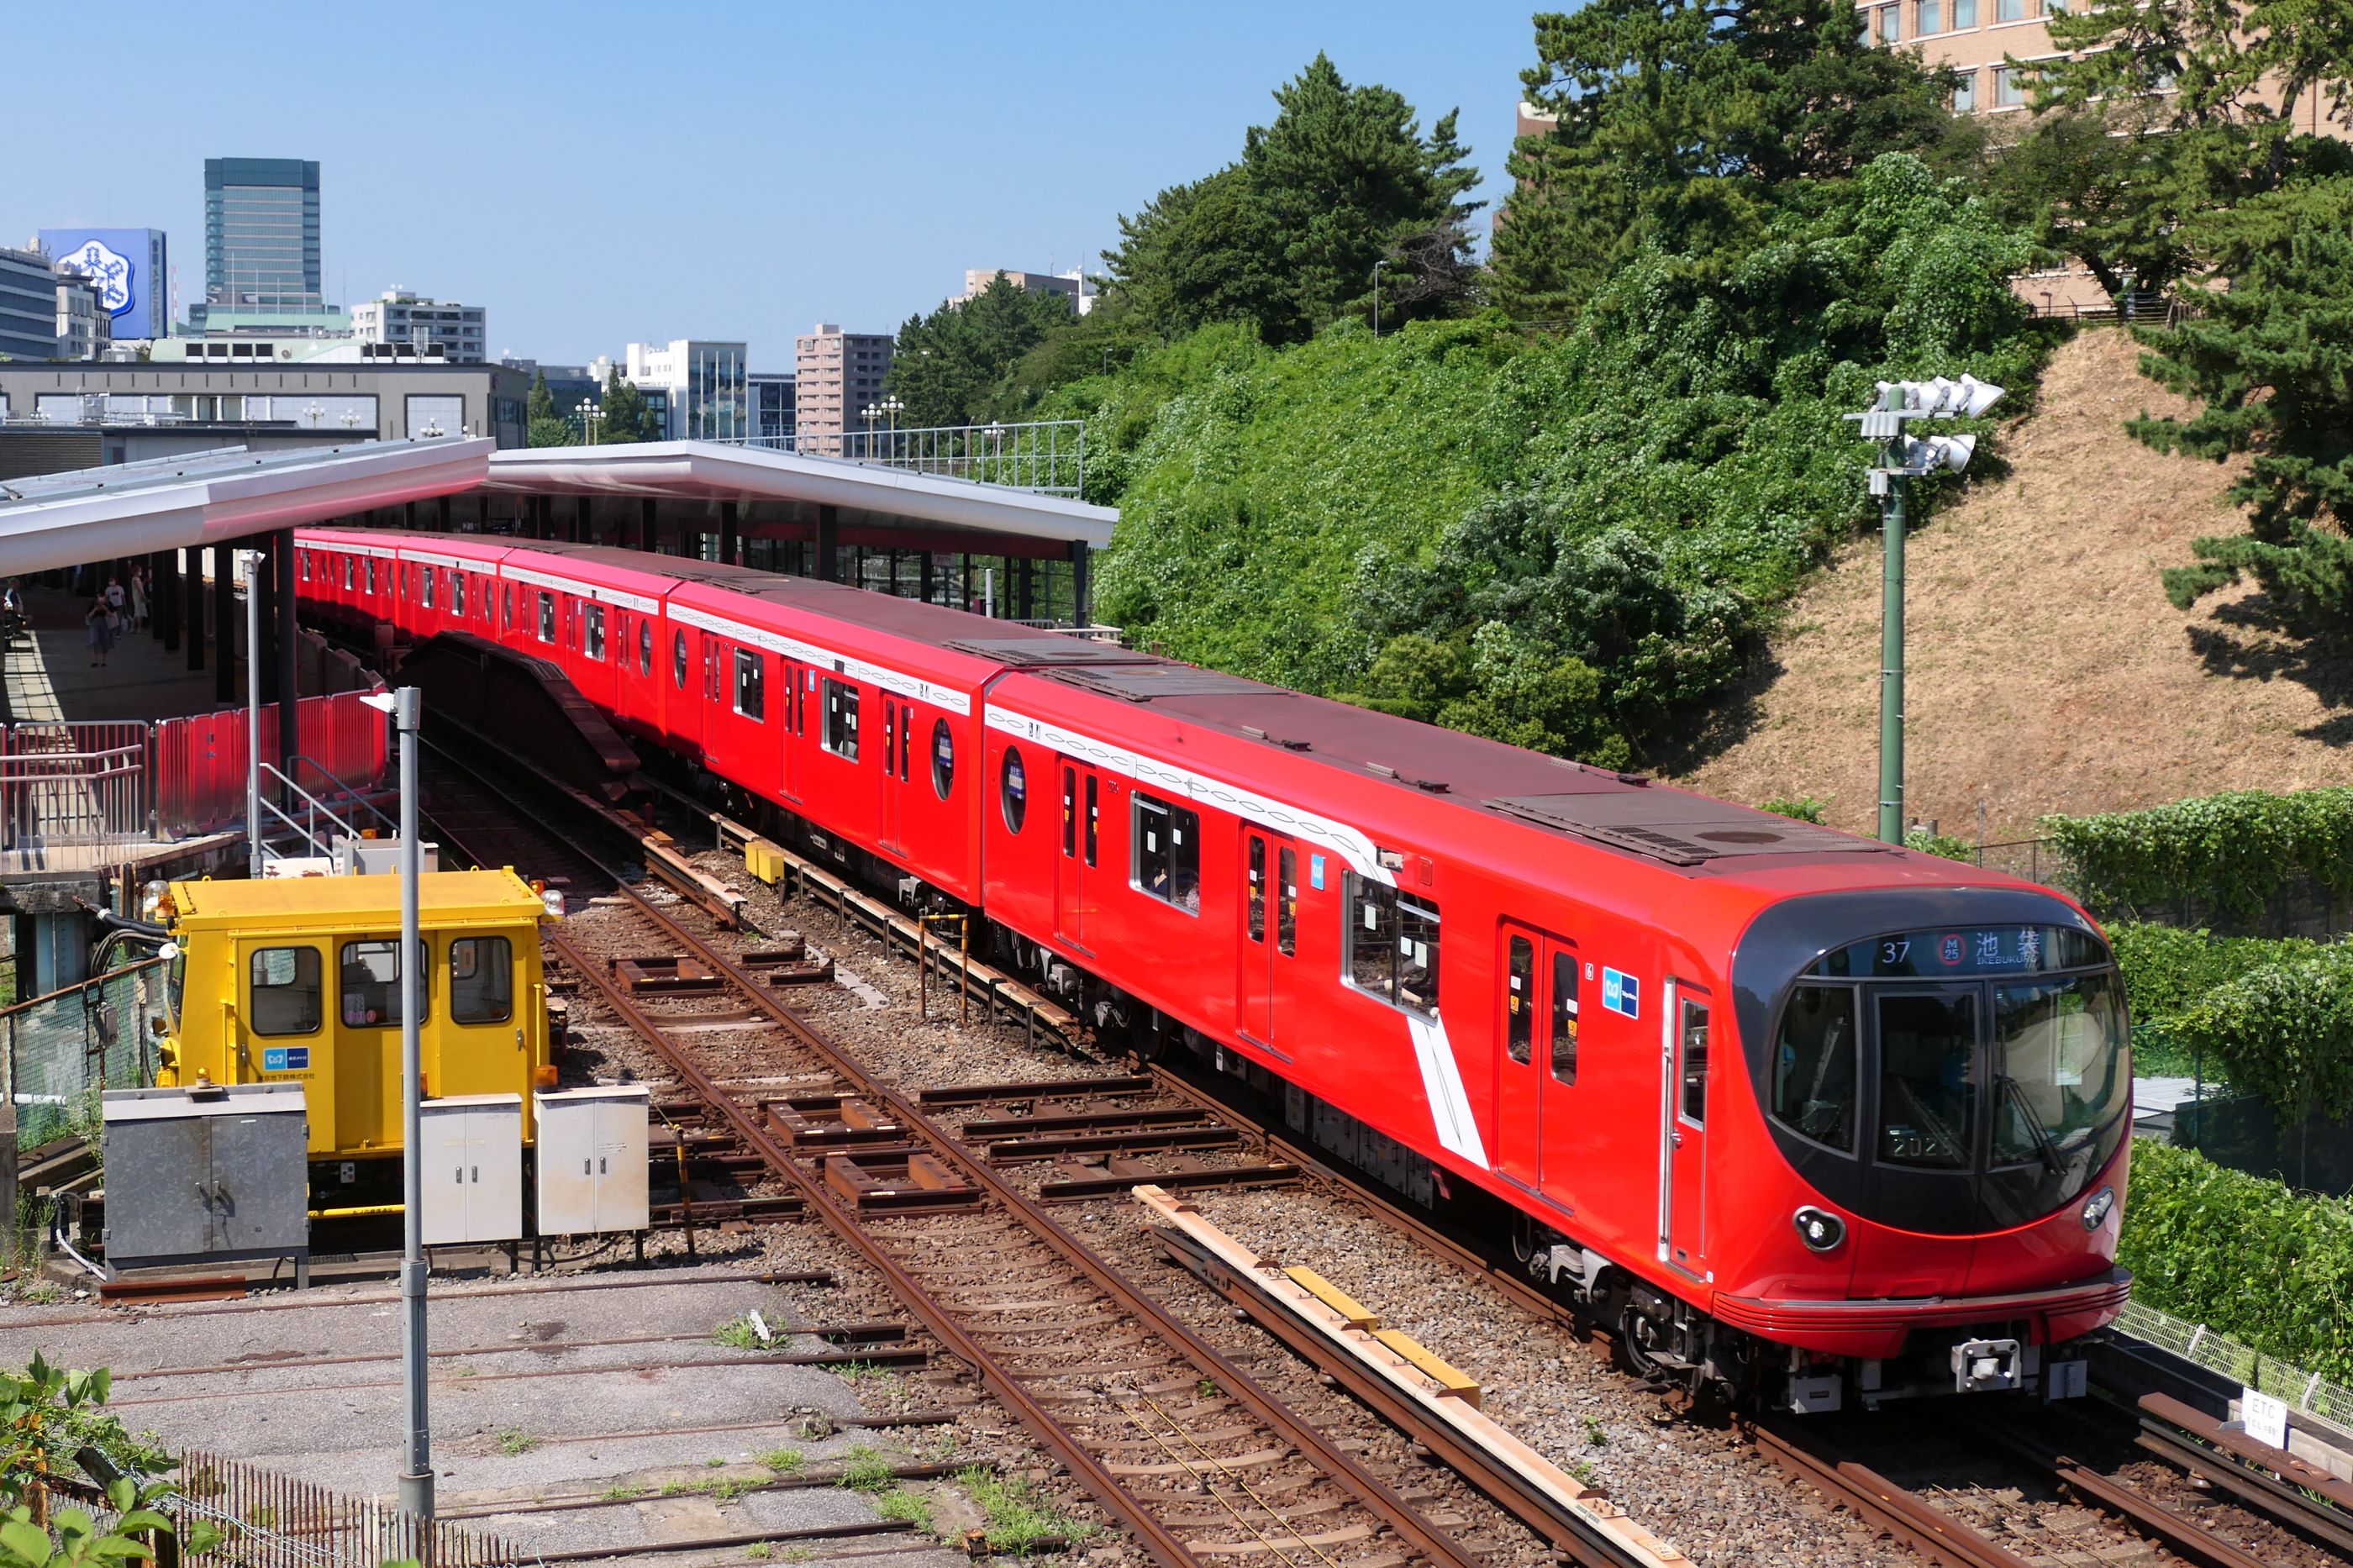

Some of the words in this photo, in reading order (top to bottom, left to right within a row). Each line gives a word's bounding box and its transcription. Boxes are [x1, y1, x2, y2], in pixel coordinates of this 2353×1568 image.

[1946, 939, 1957, 949] M
[1976, 929, 2040, 957] 池袋
[1882, 941, 1911, 964] 37
[1945, 949, 1959, 960] 25
[1977, 955, 2038, 966] IKEBUKURO
